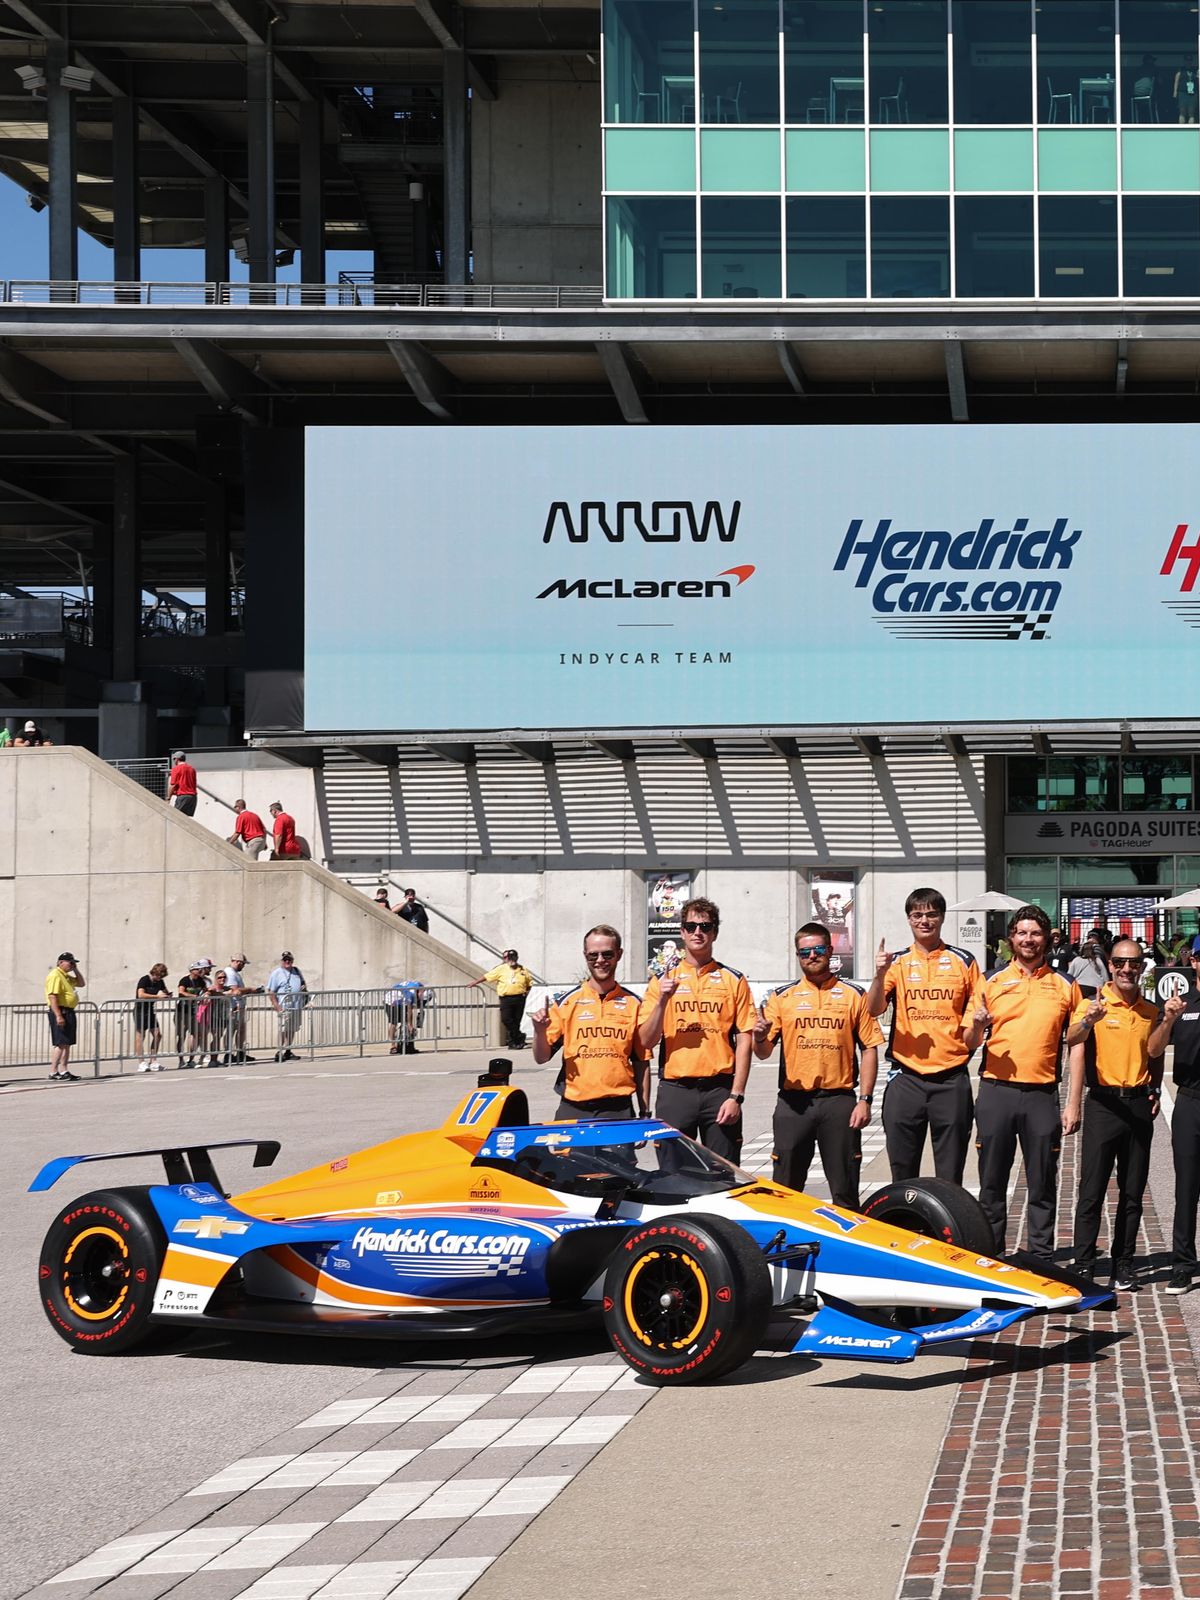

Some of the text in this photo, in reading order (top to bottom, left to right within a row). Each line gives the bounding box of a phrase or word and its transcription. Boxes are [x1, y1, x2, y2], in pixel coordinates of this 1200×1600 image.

[542, 501, 741, 543] ARROW
[832, 518, 1083, 588] Hendrick
[534, 578, 732, 600] McLaren
[871, 572, 1062, 613] Cars.com
[559, 652, 733, 665] INDYCAR TEAM
[1070, 821, 1143, 838] PAGODA
[456, 1091, 501, 1126] 17
[470, 1190, 500, 1199] MISSION
[63, 1205, 131, 1231] Firestone
[625, 1226, 706, 1252] Firestone
[651, 1329, 721, 1375] FIREHAWK
[818, 1335, 891, 1349] McLaren
